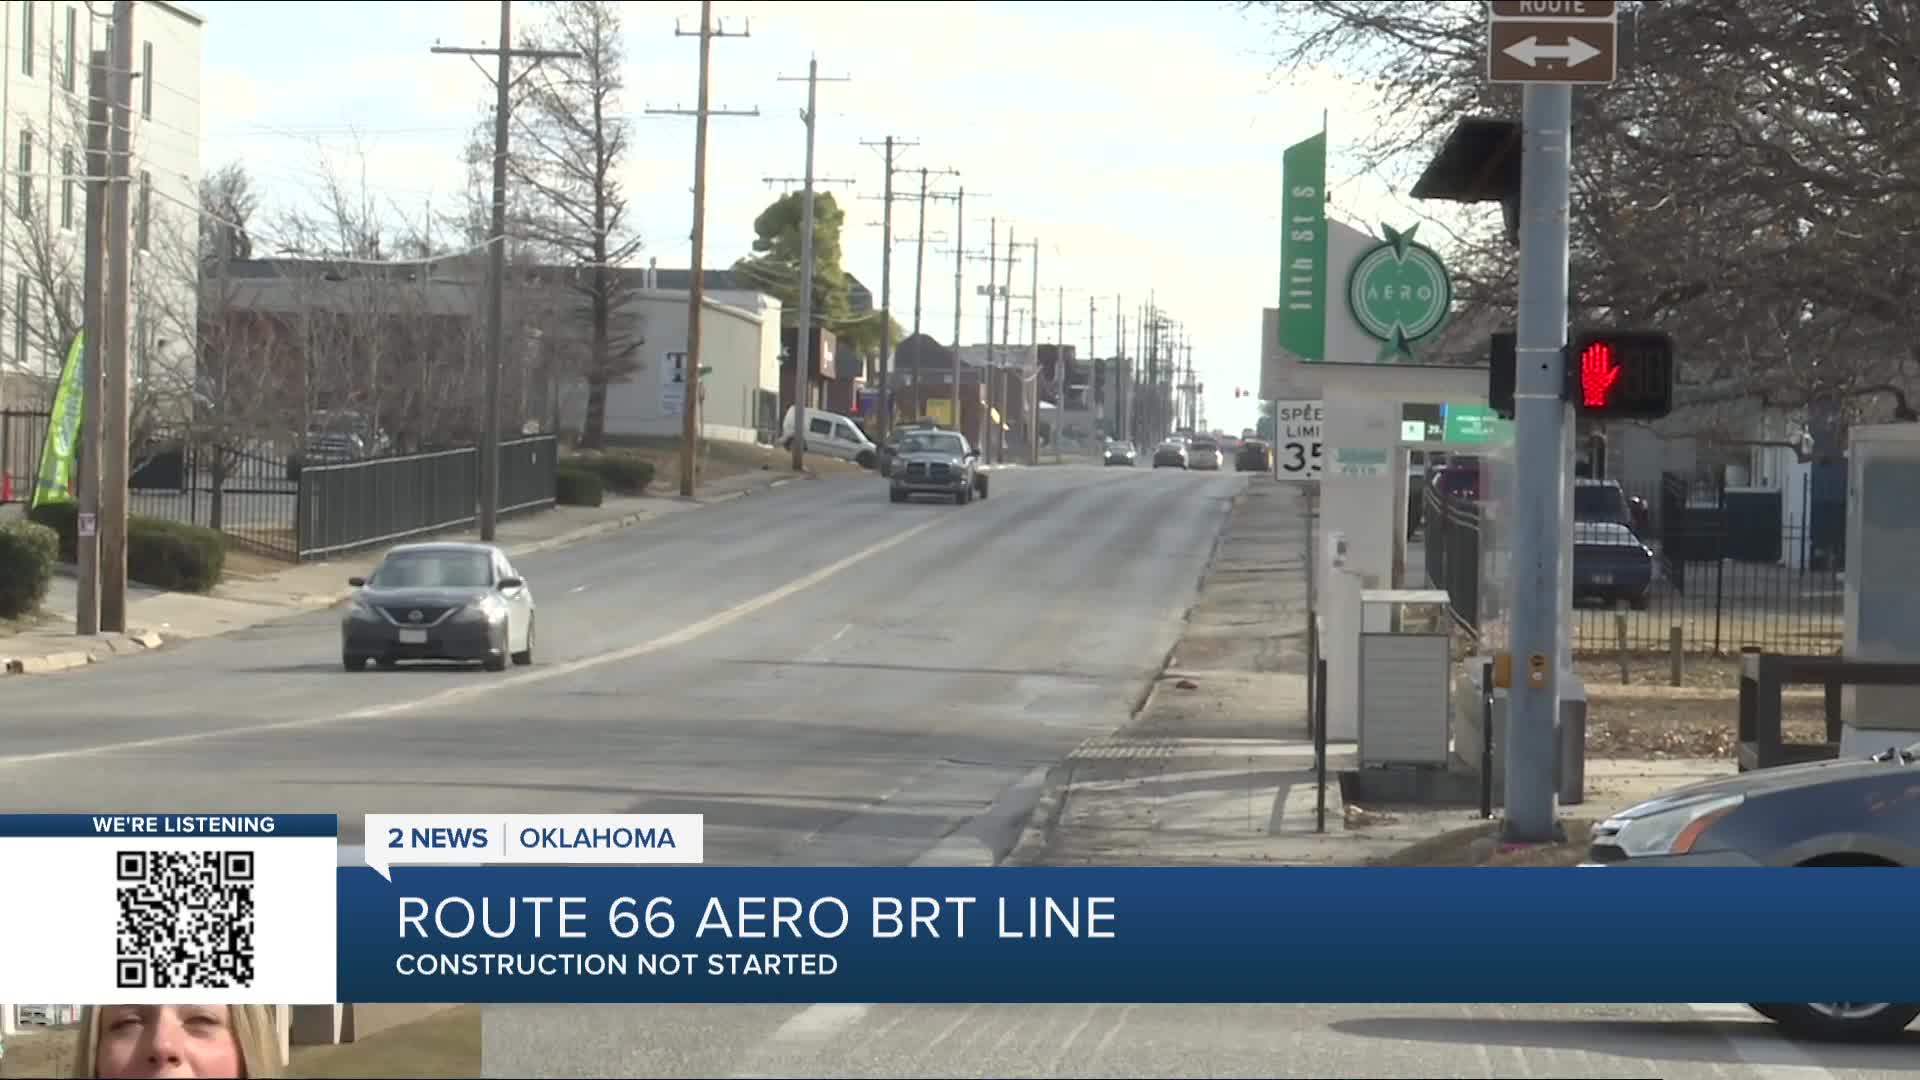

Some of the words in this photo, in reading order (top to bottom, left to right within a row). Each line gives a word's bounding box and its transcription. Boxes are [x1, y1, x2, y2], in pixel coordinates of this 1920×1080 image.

[1519, 1, 1585, 13] ROUTE
[1290, 184, 1316, 199] S
[1289, 214, 1315, 242] St
[1288, 256, 1313, 311] 11th
[1366, 284, 1432, 302] AERO
[1281, 407, 1324, 421] SPEE
[1287, 425, 1320, 438] LIMI
